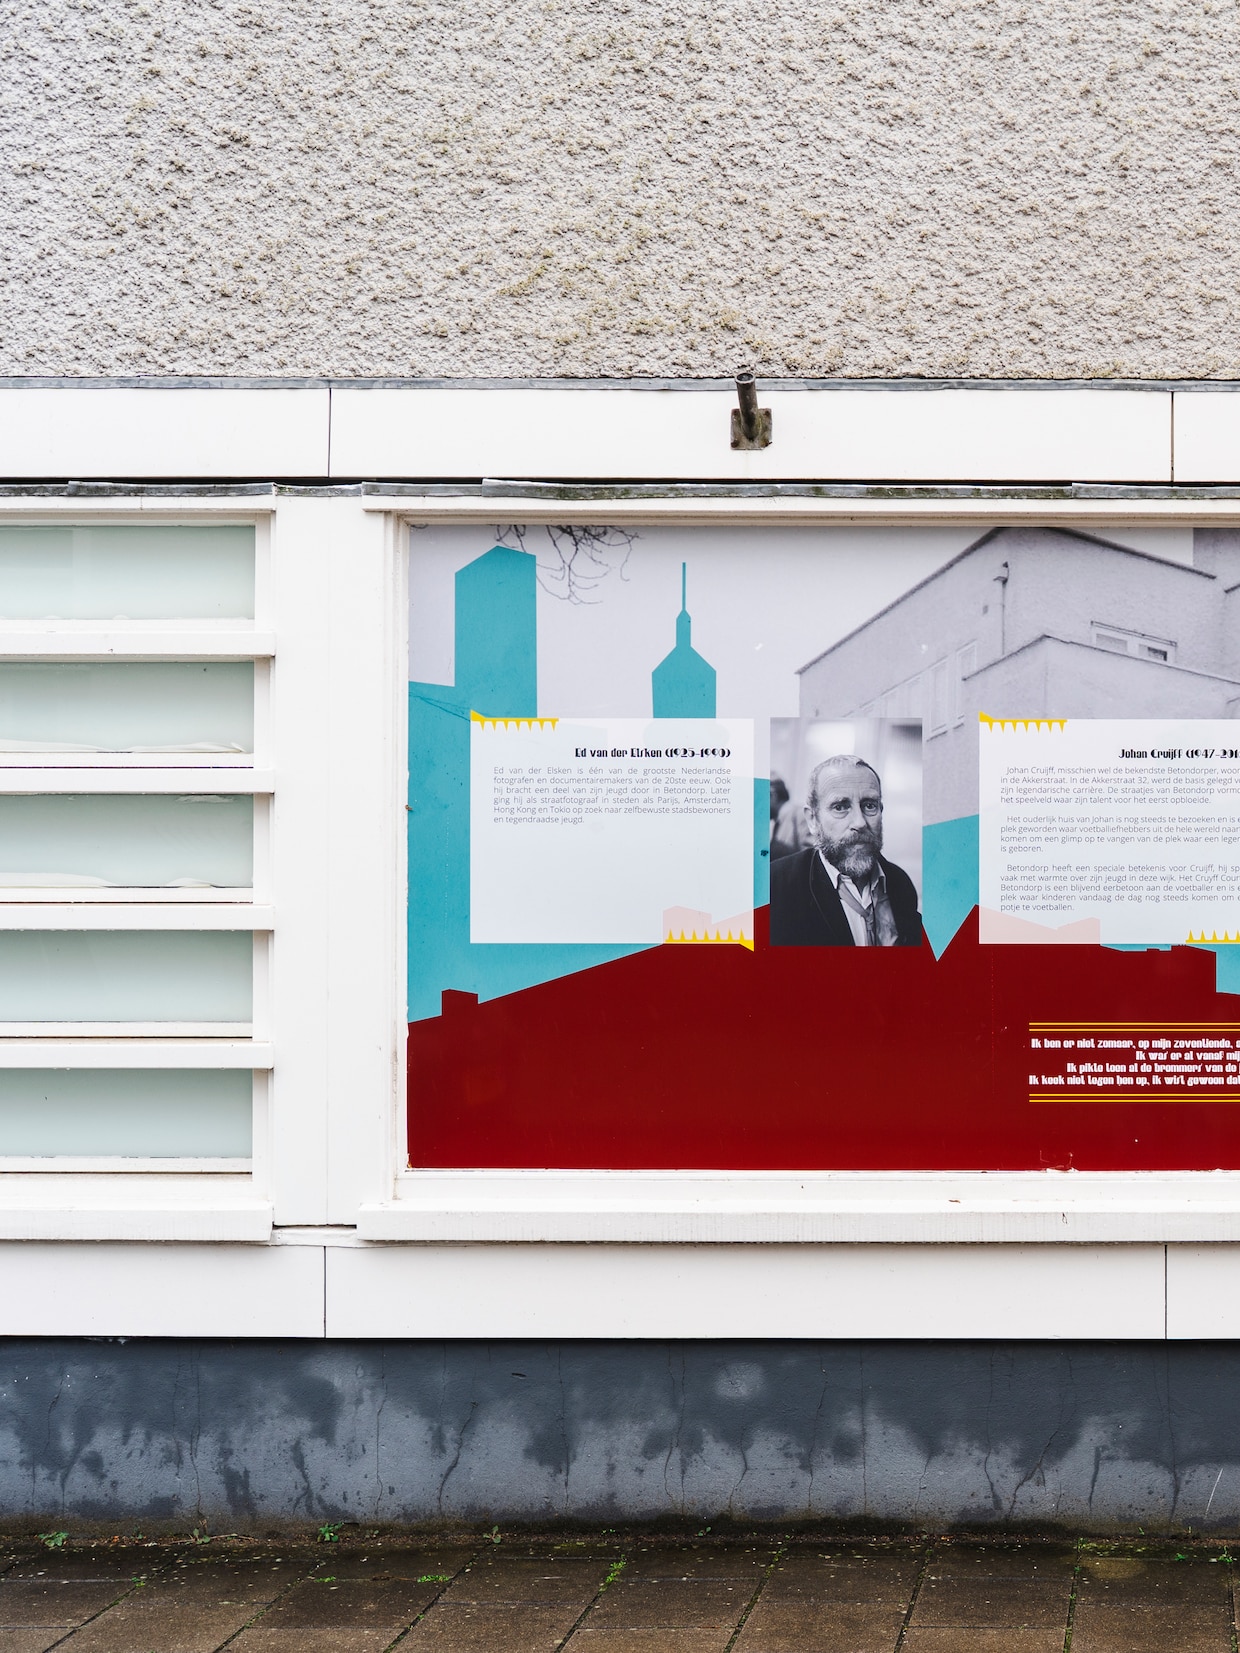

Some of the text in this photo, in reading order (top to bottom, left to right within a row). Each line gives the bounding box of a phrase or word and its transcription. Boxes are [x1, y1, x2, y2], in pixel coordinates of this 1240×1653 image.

[575, 747, 731, 759] Ed van der Elsken (1925-1990)
[1118, 748, 1148, 759] Johan
[1150, 748, 1182, 760] Cruijff
[493, 767, 504, 775] Ed
[528, 767, 542, 775] der
[547, 767, 572, 775] Elsken
[577, 767, 584, 775] is
[588, 767, 604, 775] één
[627, 767, 638, 775] de
[642, 767, 676, 777] grootste
[681, 767, 732, 775] Nederlandse
[1005, 766, 1029, 774] Johan
[1030, 766, 1056, 776] Cruijff,
[1057, 766, 1096, 774] misschien
[1097, 766, 1111, 774] wel
[1112, 766, 1123, 774] de
[1124, 766, 1166, 774] bekendste
[1167, 766, 1219, 776] Betondorper,
[493, 776, 534, 786] fotografen
[549, 776, 633, 784] documentairemakers
[651, 776, 662, 784] de
[665, 776, 687, 784] 20ste
[714, 776, 731, 784] Ook
[1000, 776, 1008, 784] in
[1009, 776, 1020, 784] de
[1021, 776, 1068, 784] Akkerstraat.
[1070, 776, 1078, 784] In
[1079, 776, 1090, 784] de
[1091, 776, 1135, 784] Akkerstraat
[1137, 776, 1149, 785] 32,
[1151, 776, 1171, 784] werd
[1173, 776, 1183, 784] de
[1185, 776, 1205, 784] basis
[1206, 776, 1233, 786] gelegd
[493, 786, 503, 796] hij
[506, 786, 532, 794] bracht
[552, 786, 570, 794] deel
[589, 786, 603, 796] zijn
[605, 786, 628, 796] jeugd
[630, 786, 650, 794] door
[653, 786, 660, 794] in
[663, 786, 707, 796] Betondorp.
[711, 786, 731, 794] Later
[1001, 786, 1014, 796] zijn
[1016, 786, 1070, 796] legendarische
[1073, 786, 1104, 794] carrière.
[1108, 786, 1118, 794] De
[1121, 786, 1154, 796] straatjes
[1173, 786, 1215, 796] Betondorp
[493, 796, 731, 806] ging hij als straatfotograaf in steden als Parijs, Amsterdam,
[1000, 795, 1014, 803] het
[1015, 795, 1052, 805] speelveld
[1074, 795, 1088, 805] zijn
[1089, 795, 1112, 803] talent
[1133, 795, 1147, 803] het
[1148, 795, 1169, 803] eerst
[1170, 795, 1211, 805] opbloeide.
[493, 806, 515, 816] Hong
[516, 806, 537, 816] Kong
[549, 806, 571, 814] Tokio
[572, 808, 583, 816] op
[584, 806, 603, 814] zoek
[623, 806, 670, 814] zelfbewuste
[671, 806, 731, 814] stadsbewoners
[505, 815, 559, 825] tegendraadse
[561, 815, 584, 825] jeugd.
[1000, 844, 1043, 854] is geboren.
[1000, 903, 1075, 913] potje te voetballen.
[1136, 1051, 1146, 1060] Ik
[1148, 1051, 1168, 1060] was
[1184, 1051, 1194, 1060] al
[1196, 1051, 1224, 1060] vanaf
